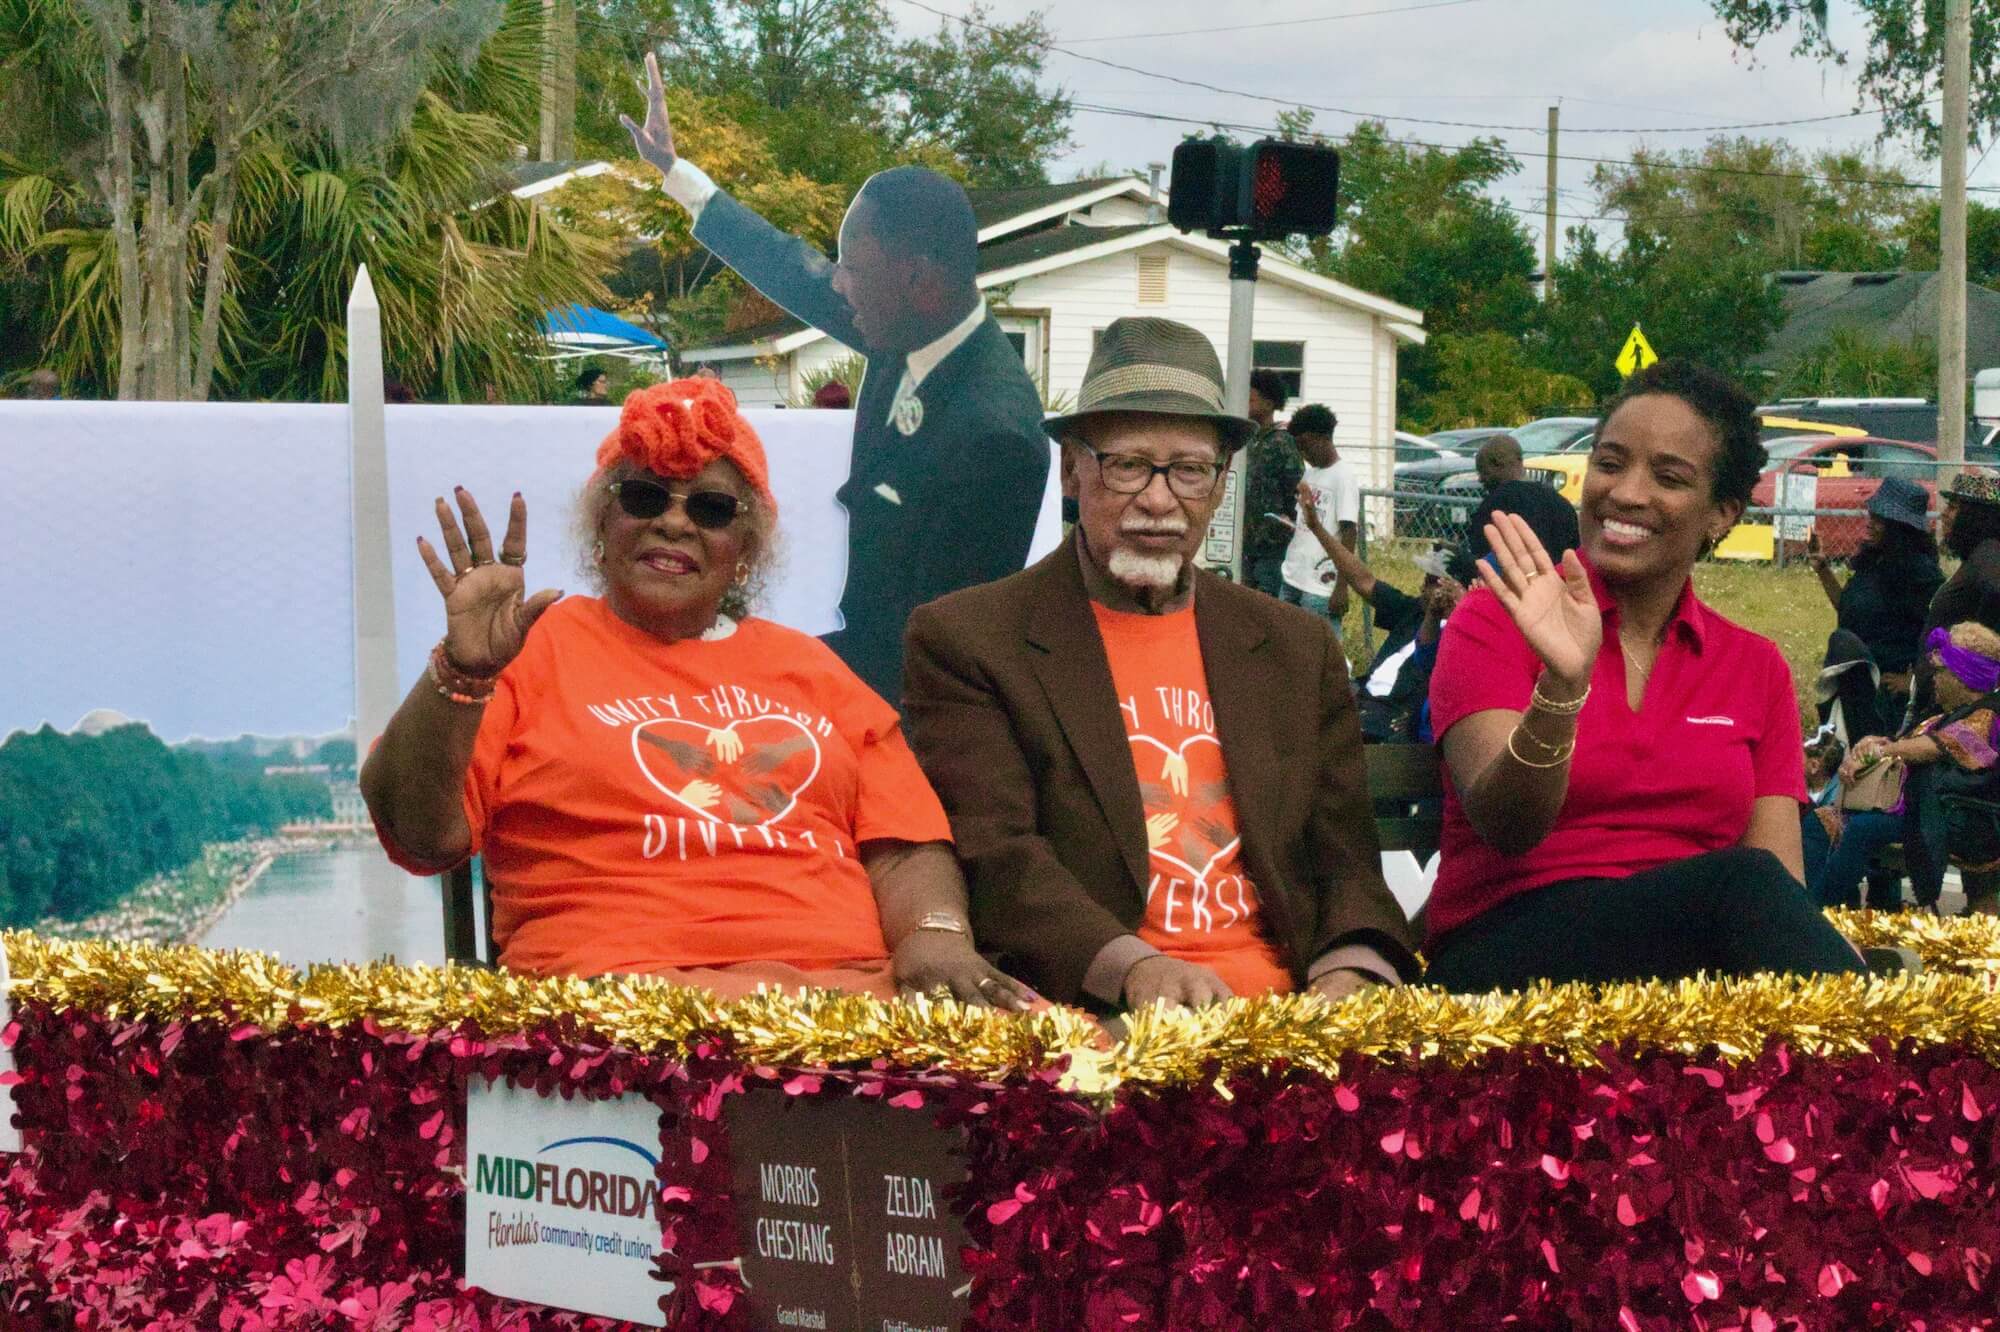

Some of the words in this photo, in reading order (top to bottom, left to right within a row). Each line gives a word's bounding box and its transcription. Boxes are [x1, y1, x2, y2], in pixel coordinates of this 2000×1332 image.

[587, 693, 681, 727] UNITY
[475, 1153, 662, 1222] MIDFLORIDA
[760, 1162, 819, 1208] MORRIS
[883, 1174, 937, 1220] ZELDA
[488, 1210, 540, 1250] Florida's
[540, 1225, 593, 1256] community
[595, 1231, 623, 1257] credit
[624, 1235, 652, 1262] union
[756, 1217, 835, 1266] CHESTANG
[886, 1231, 947, 1280] ABRAM
[776, 1304, 798, 1327] Grand
[798, 1306, 827, 1330] Marshal
